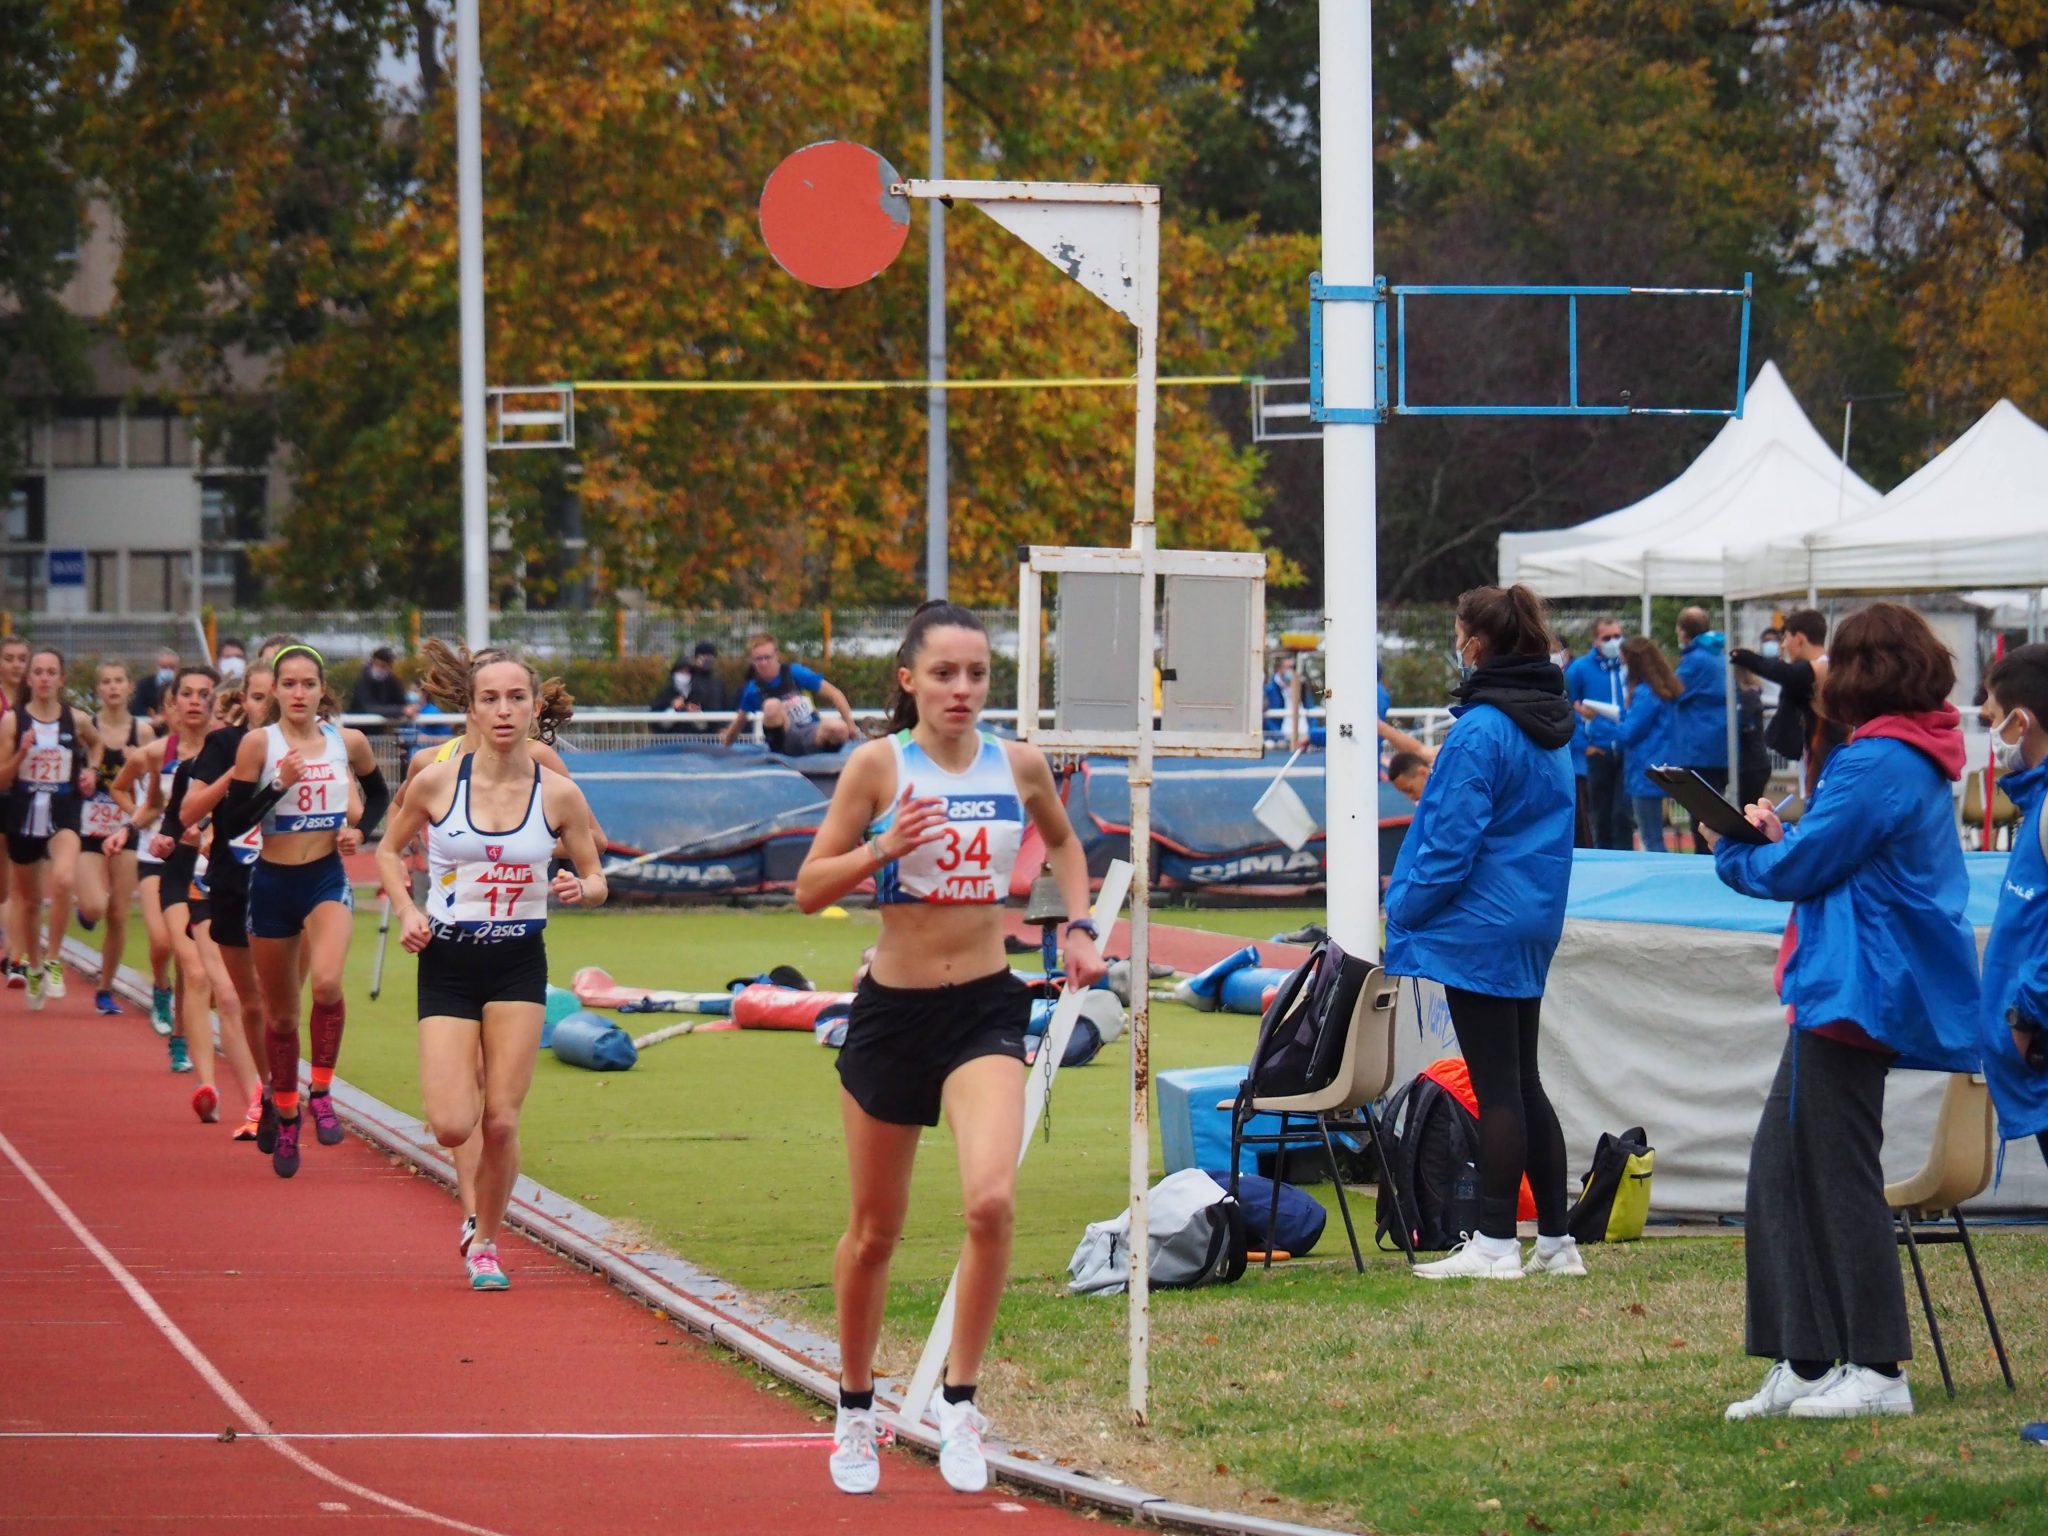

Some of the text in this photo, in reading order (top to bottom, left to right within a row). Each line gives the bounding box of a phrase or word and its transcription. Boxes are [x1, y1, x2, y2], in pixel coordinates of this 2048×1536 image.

[31, 763, 61, 780] 121
[298, 784, 327, 812] 81
[90, 804, 122, 823] 294
[948, 800, 996, 818] asics
[306, 816, 335, 829] asics
[936, 826, 992, 871] 34
[486, 866, 532, 881] MAIF
[937, 879, 996, 900] MAIF
[483, 886, 524, 917] 17
[491, 923, 527, 937] asics
